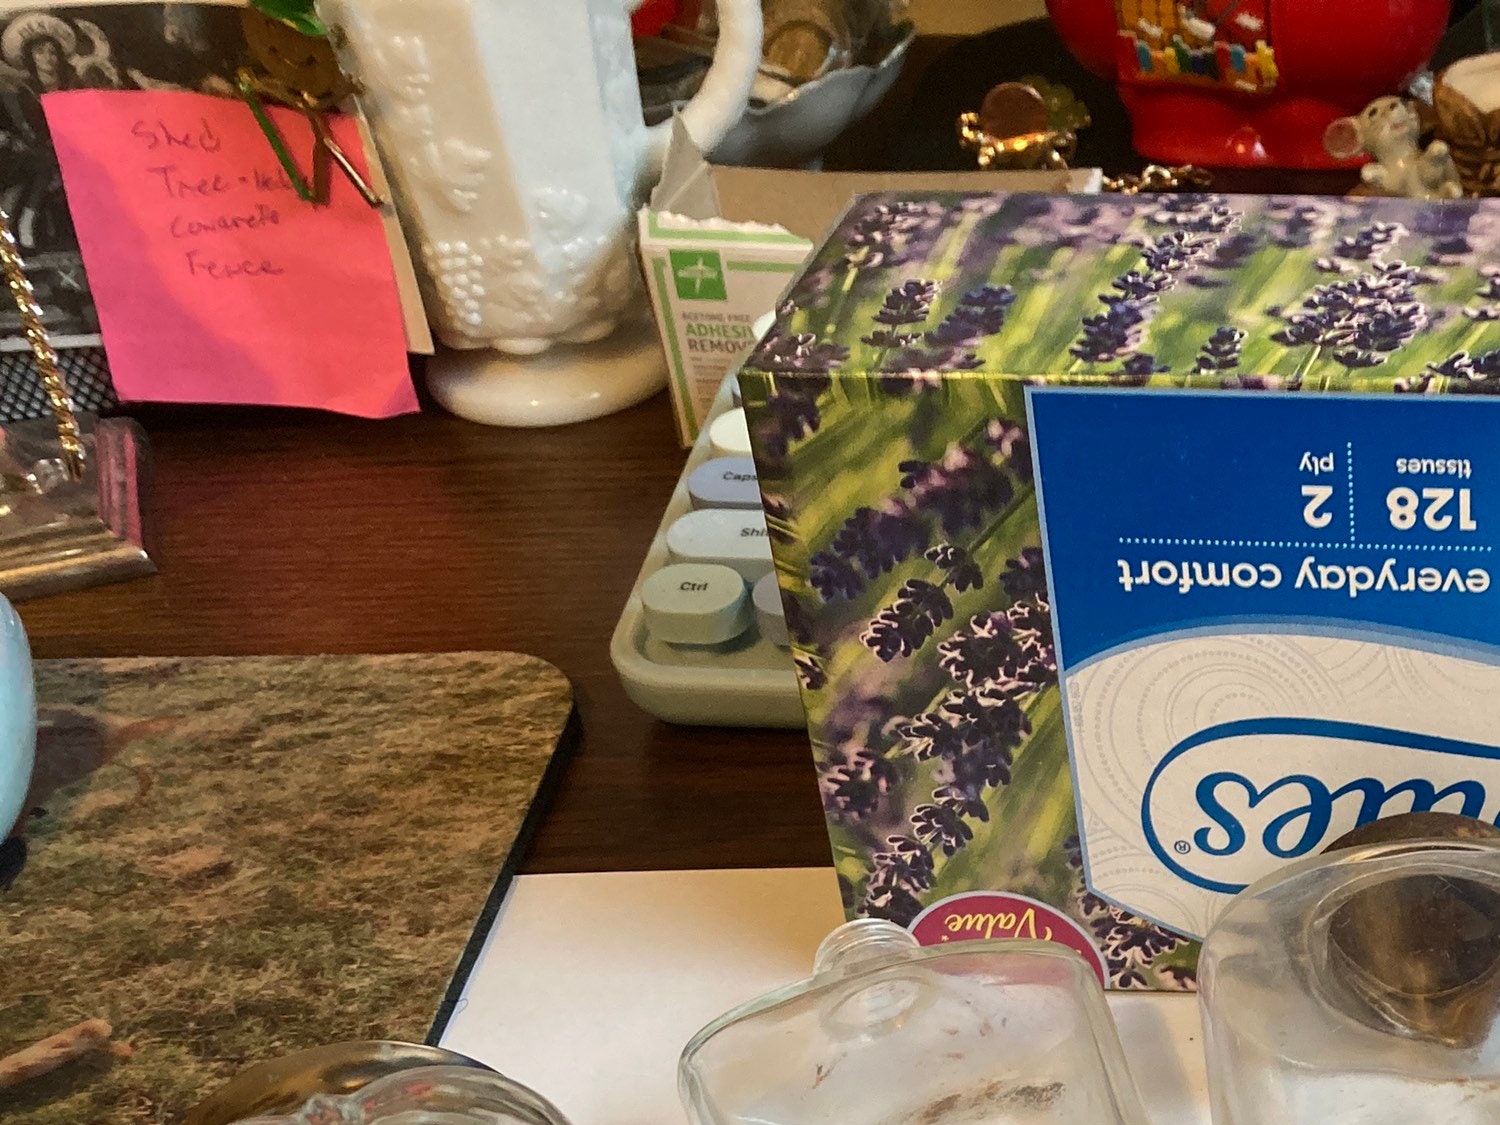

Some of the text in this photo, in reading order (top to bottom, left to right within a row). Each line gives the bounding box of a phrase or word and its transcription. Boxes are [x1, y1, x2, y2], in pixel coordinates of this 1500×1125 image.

[131, 118, 221, 153] Shed
[1299, 451, 1335, 473] ply
[1396, 457, 1472, 479] tissues
[1301, 485, 1333, 528] 2
[1386, 486, 1477, 532] 128
[680, 581, 709, 592] Ctrl
[1117, 556, 1491, 598] everyday comfort
[944, 908, 1052, 941] Value
